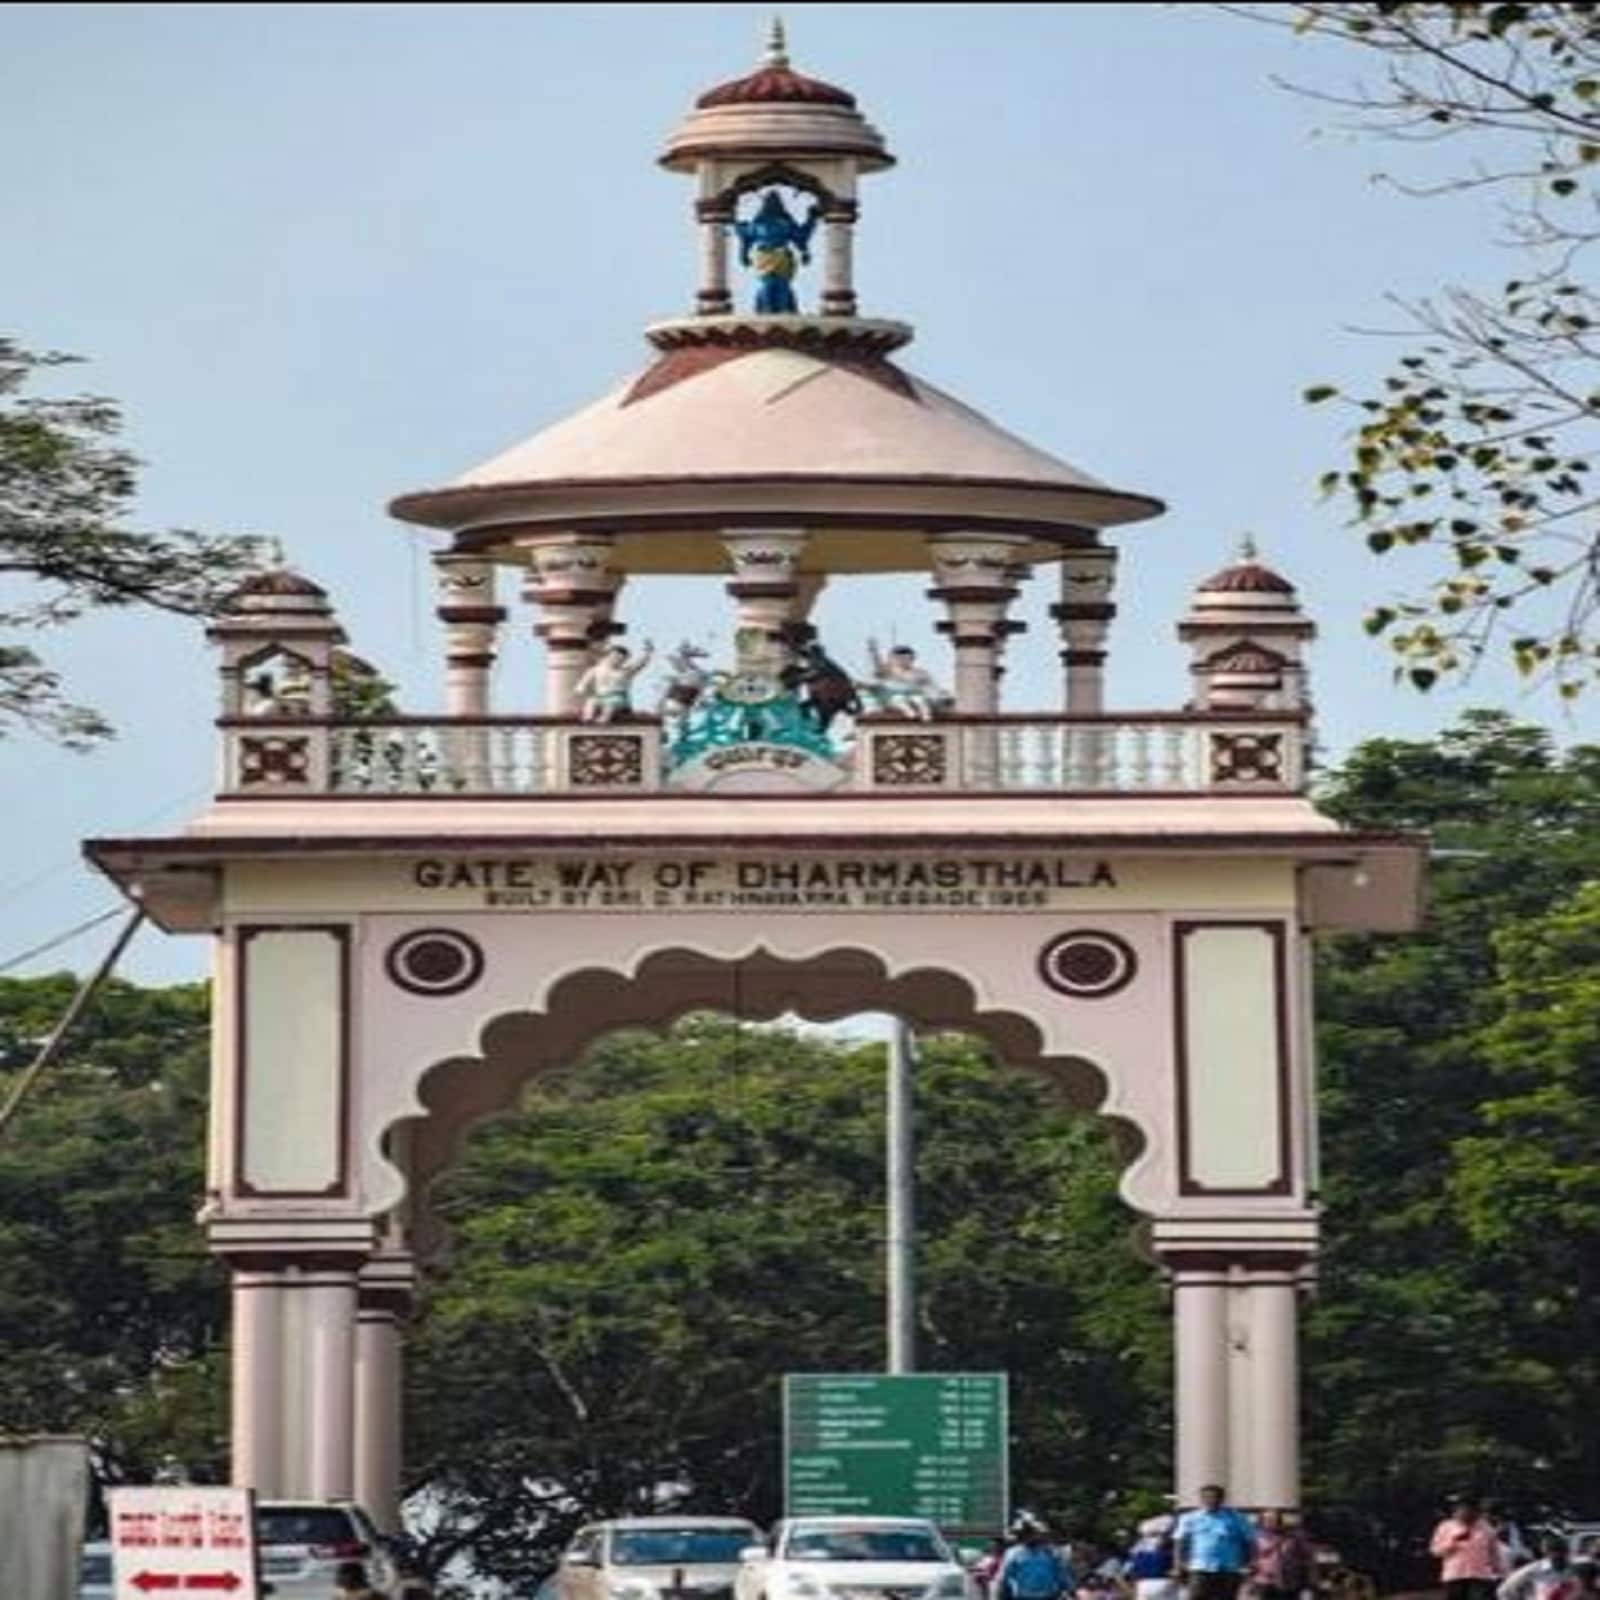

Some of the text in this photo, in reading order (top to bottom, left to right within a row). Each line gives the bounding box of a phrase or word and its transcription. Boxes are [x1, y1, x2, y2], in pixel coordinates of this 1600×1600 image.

[414, 860, 1117, 889] GATE WAY OF DHARMASTHALA
[485, 889, 552, 905] BUILT
[562, 889, 590, 905] BY
